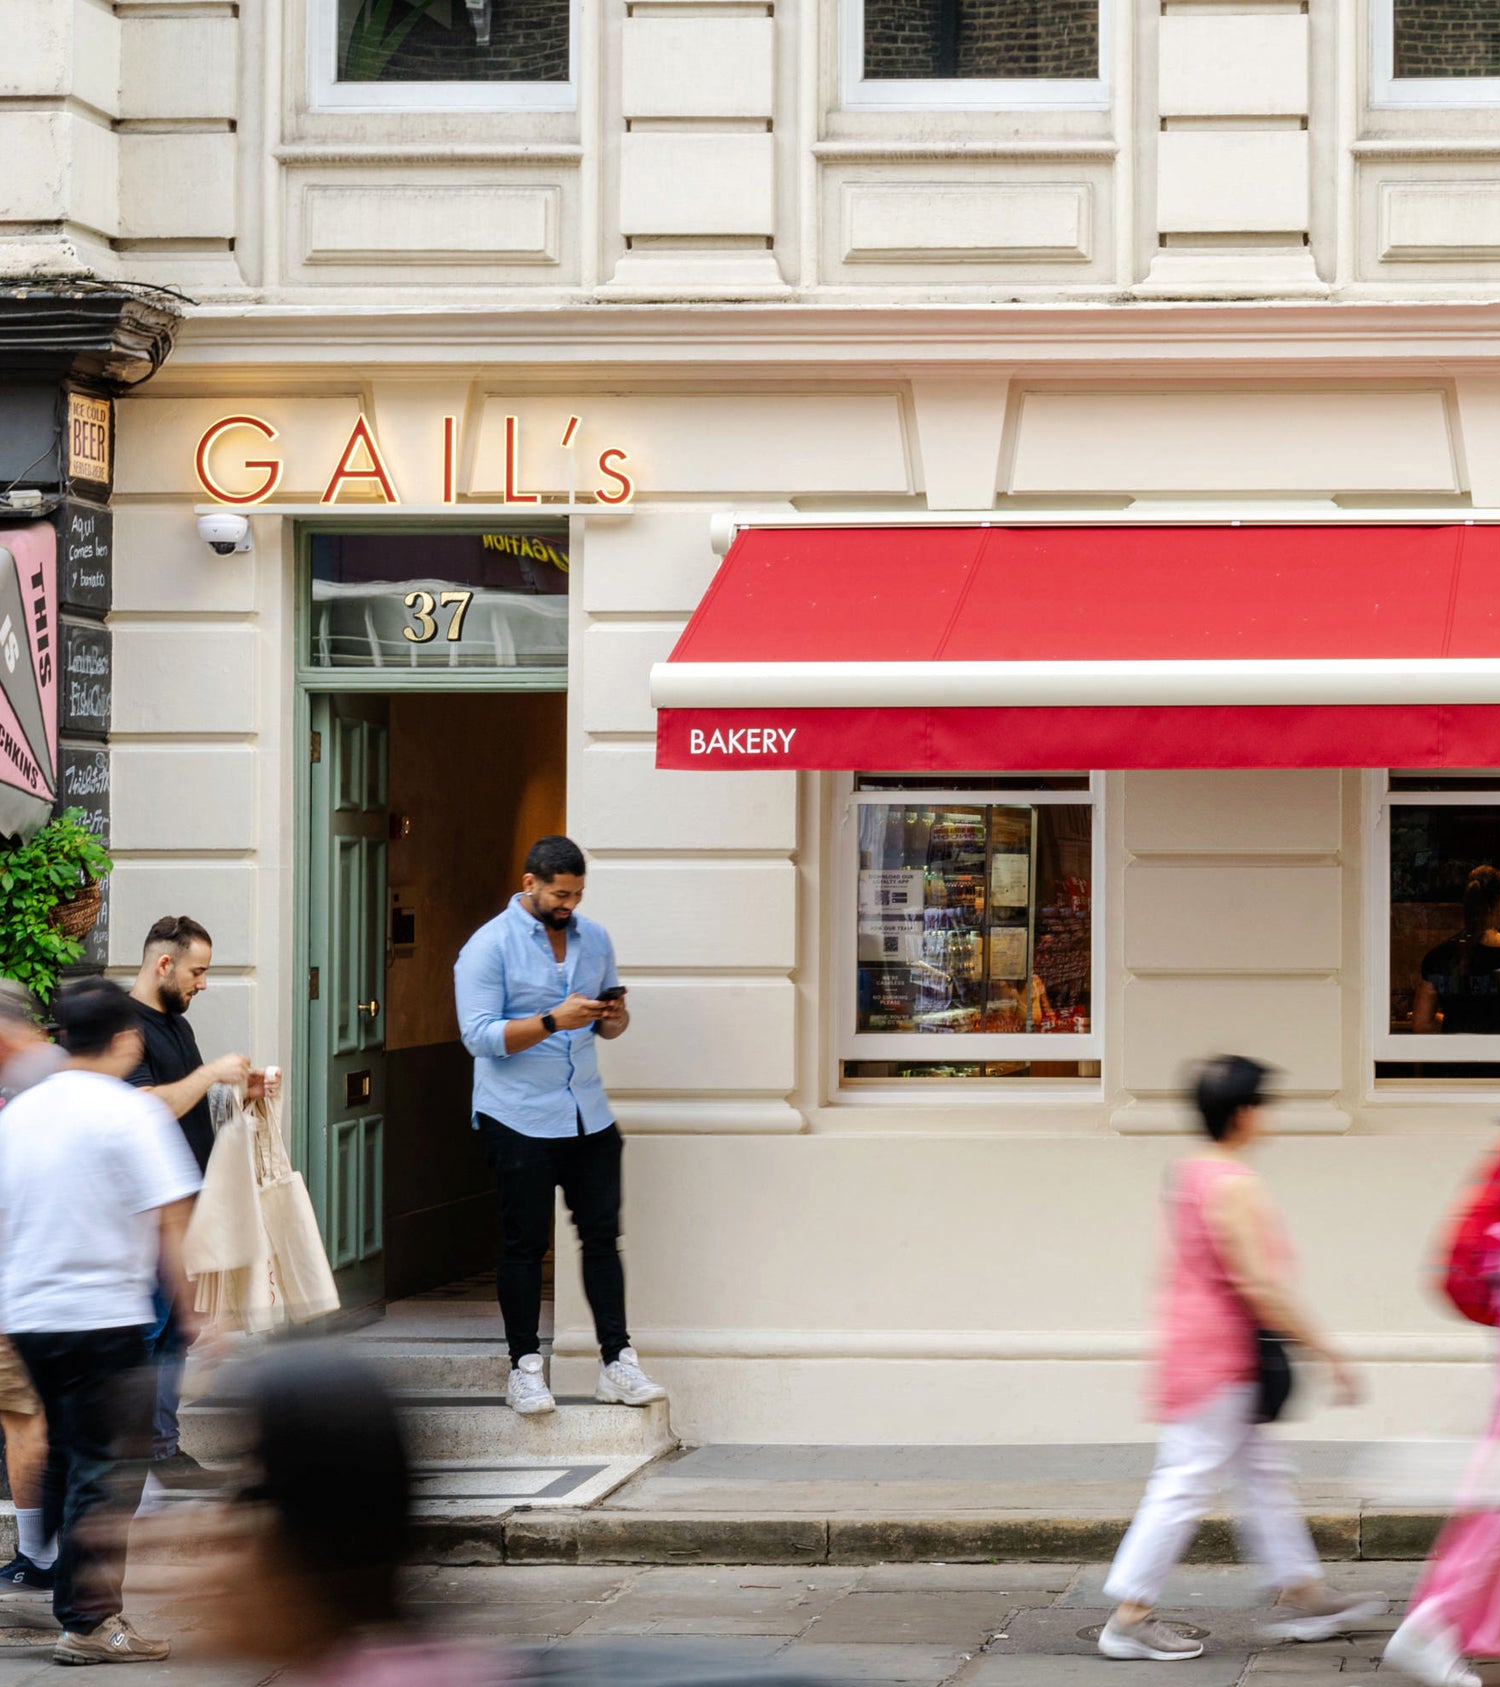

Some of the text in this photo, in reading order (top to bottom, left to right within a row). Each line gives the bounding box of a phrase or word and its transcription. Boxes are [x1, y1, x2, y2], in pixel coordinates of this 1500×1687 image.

[73, 401, 106, 423] ICE COLD
[73, 417, 106, 463] BEER
[195, 413, 633, 505] GAIL's
[31, 561, 52, 689] THIS
[403, 591, 474, 643] 37
[690, 728, 797, 754] BAKERY
